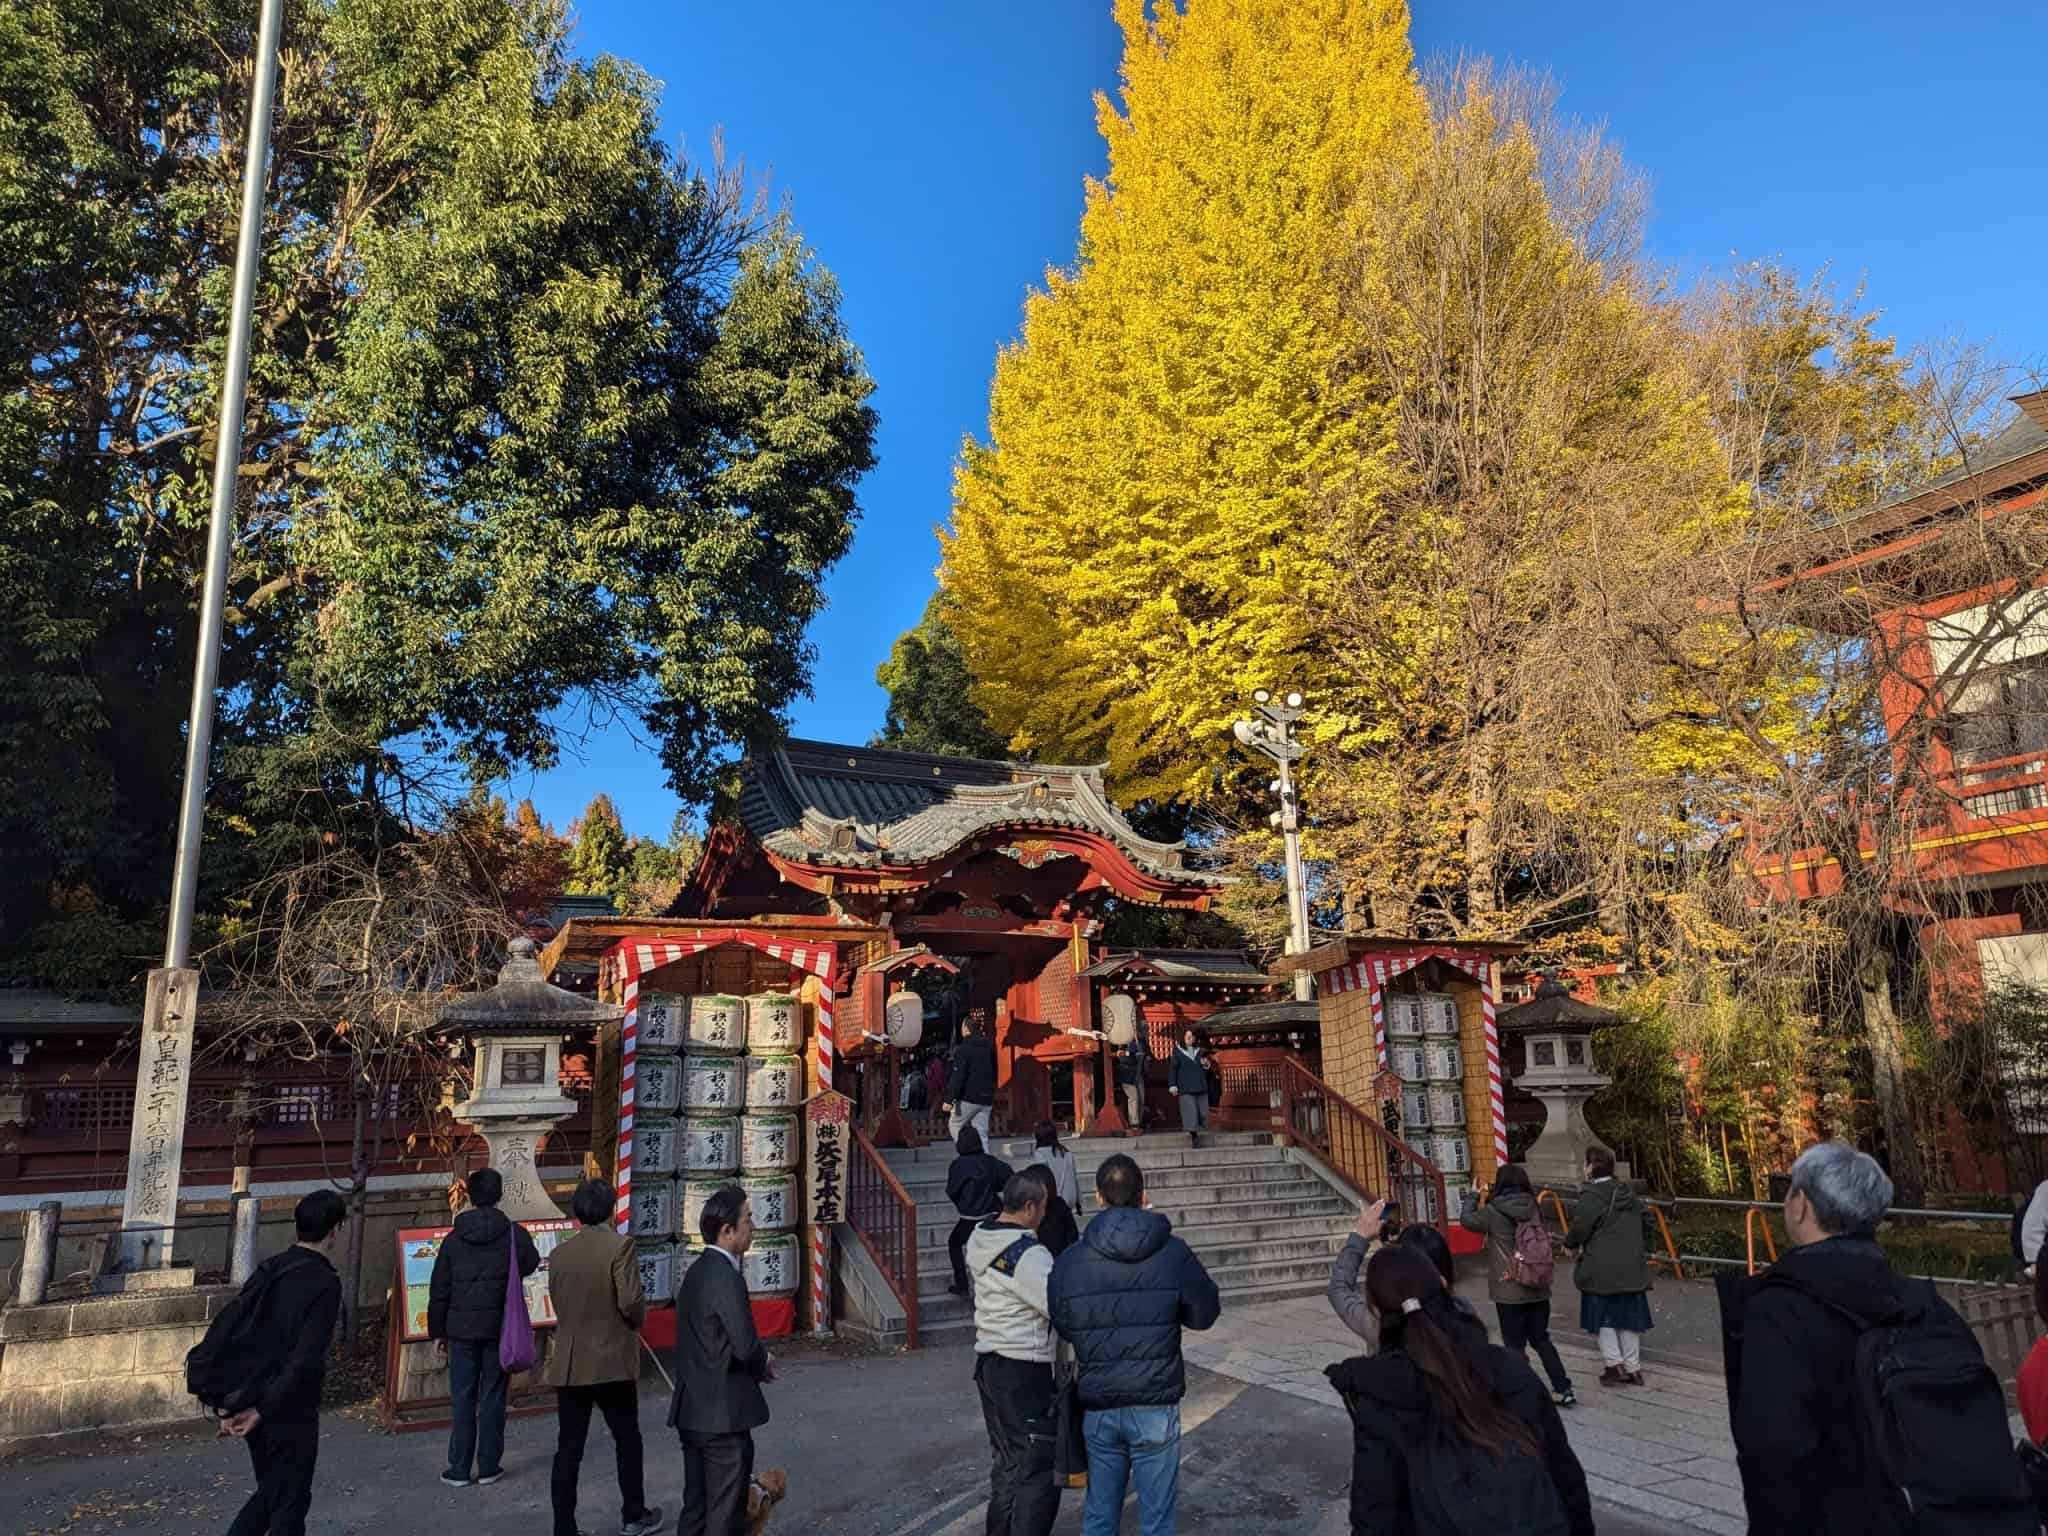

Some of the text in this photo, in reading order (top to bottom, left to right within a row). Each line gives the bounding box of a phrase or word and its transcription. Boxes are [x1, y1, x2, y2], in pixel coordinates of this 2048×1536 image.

[646, 1003, 667, 1043] 秩父錦
[706, 1009, 728, 1044] 秩父錦
[769, 1008, 788, 1043] 秩父錦
[642, 1069, 664, 1105] 秩父錦
[706, 1070, 728, 1106] 秩父錦
[767, 1068, 787, 1104] 秩父錦
[137, 1034, 179, 1215] 皇紀二千六百年記念
[640, 1131, 663, 1169] 秩父錦
[704, 1130, 725, 1166] 秩父錦
[765, 1128, 785, 1163] 秩父錦
[640, 1193, 660, 1232] 秩父錦
[762, 1190, 783, 1226] 秩父錦
[760, 1250, 781, 1289] 秩父錦
